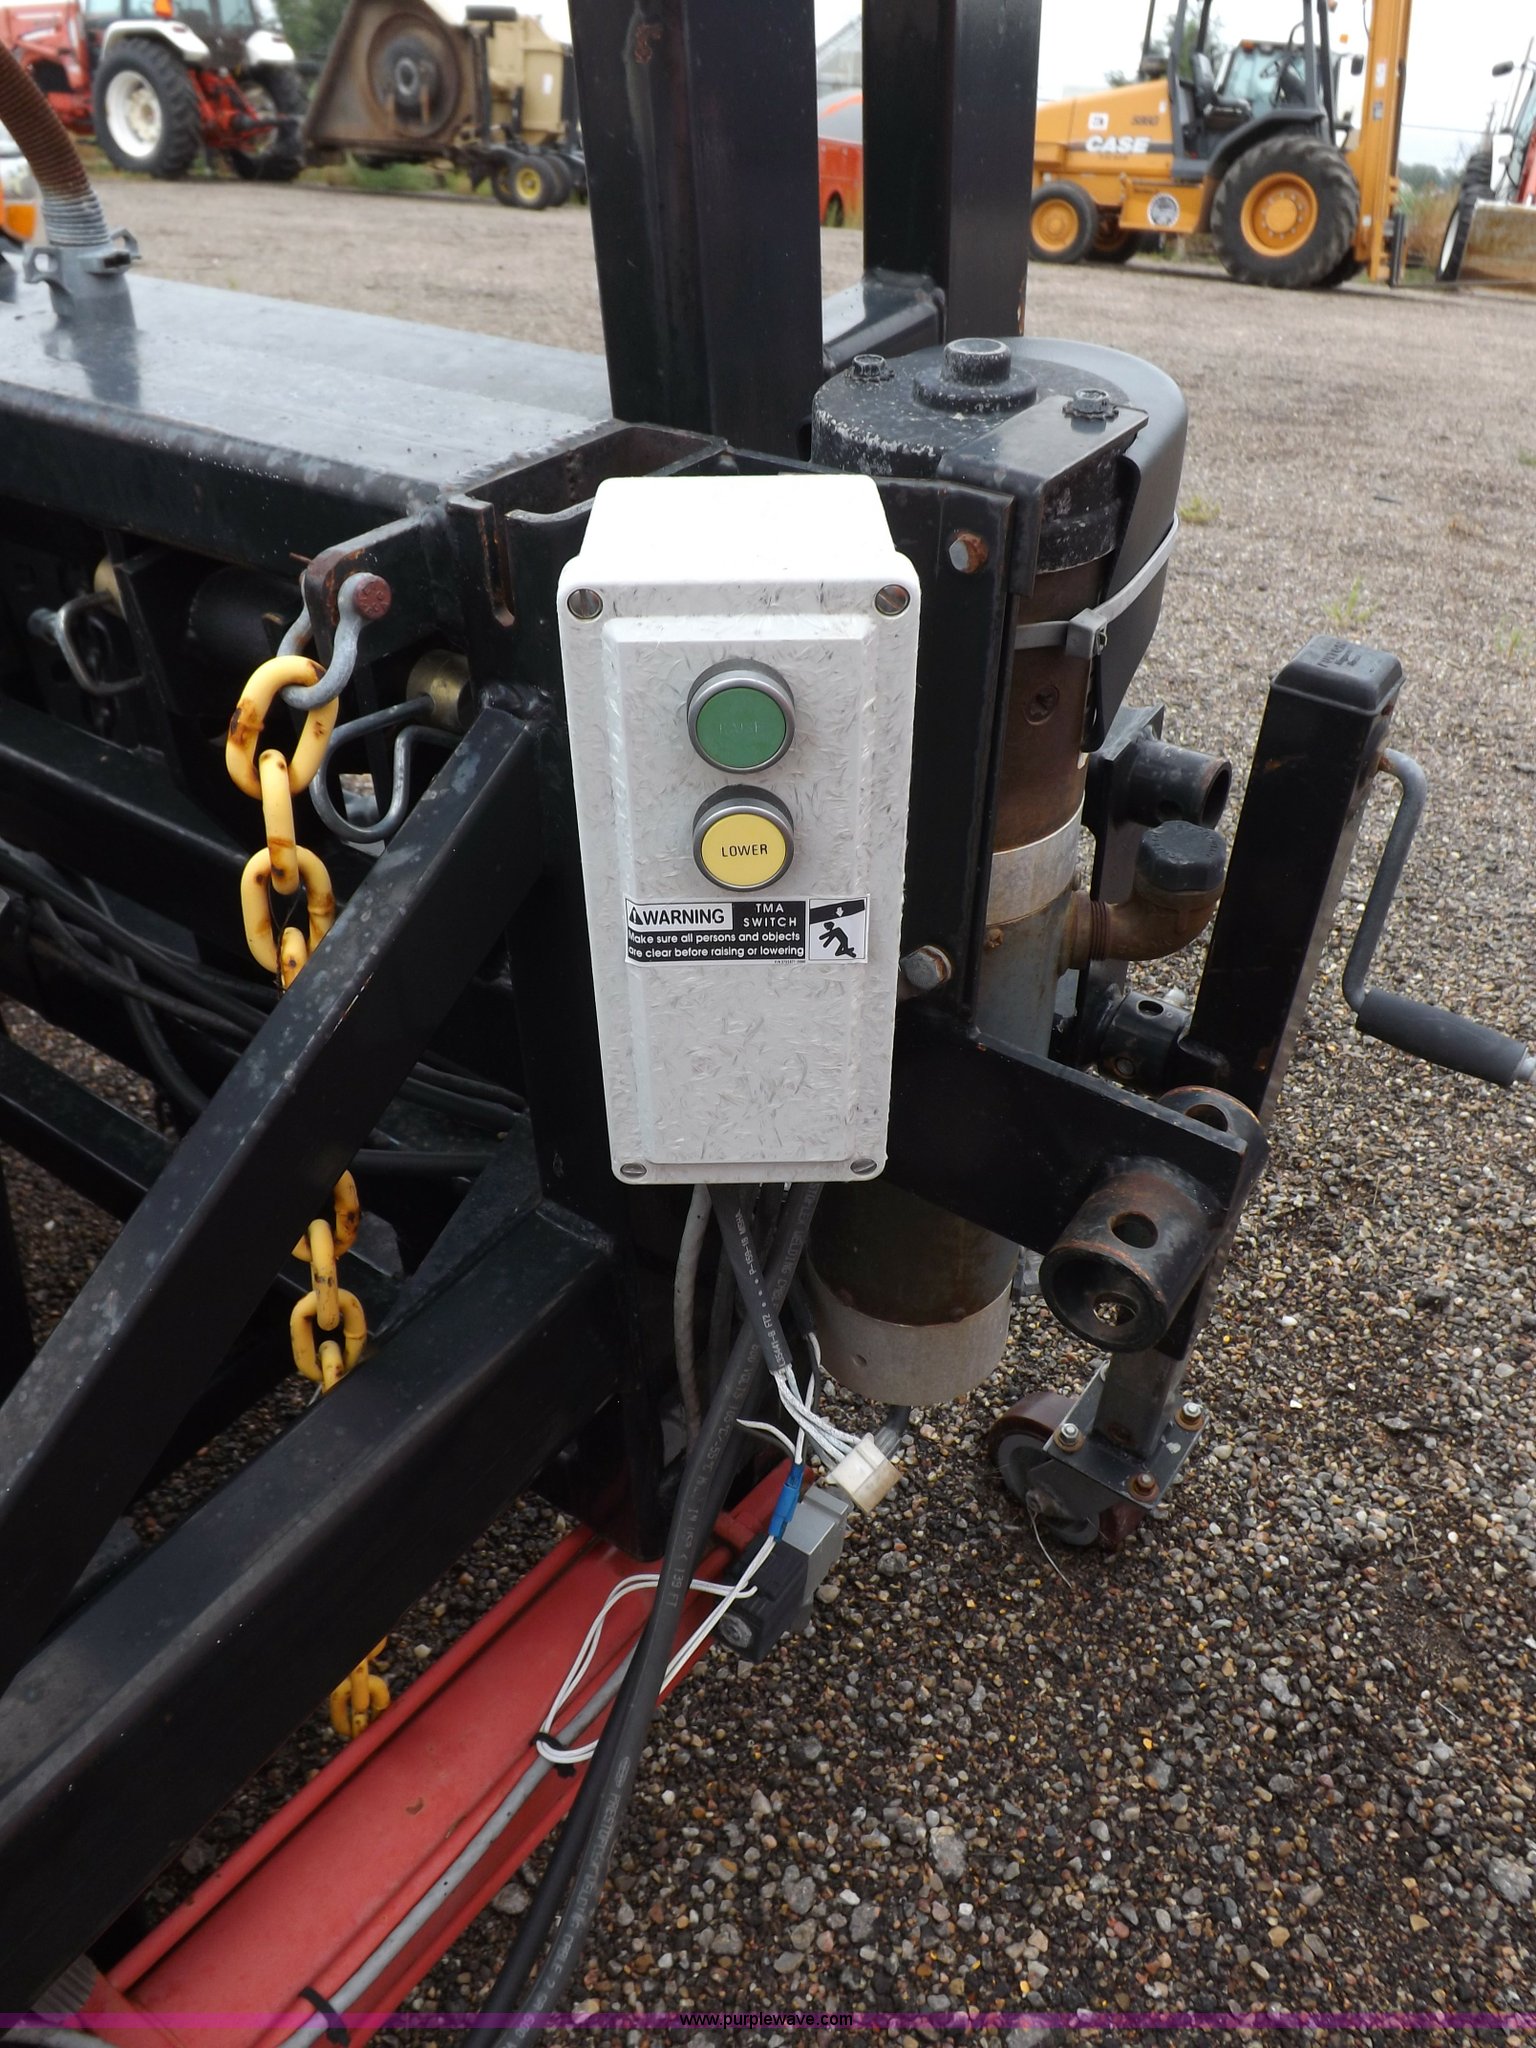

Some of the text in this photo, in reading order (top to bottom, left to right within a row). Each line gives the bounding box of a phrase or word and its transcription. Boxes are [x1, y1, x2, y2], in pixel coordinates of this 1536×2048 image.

[1085, 134, 1151, 154] CASE
[721, 843, 768, 857] LOWER
[755, 903, 784, 913] TMA
[643, 908, 725, 925] WARNING
[743, 917, 797, 928] SWITCH
[628, 931, 800, 947] Make sure all persons and objects
[628, 945, 804, 960] are clear before raising or lowering
